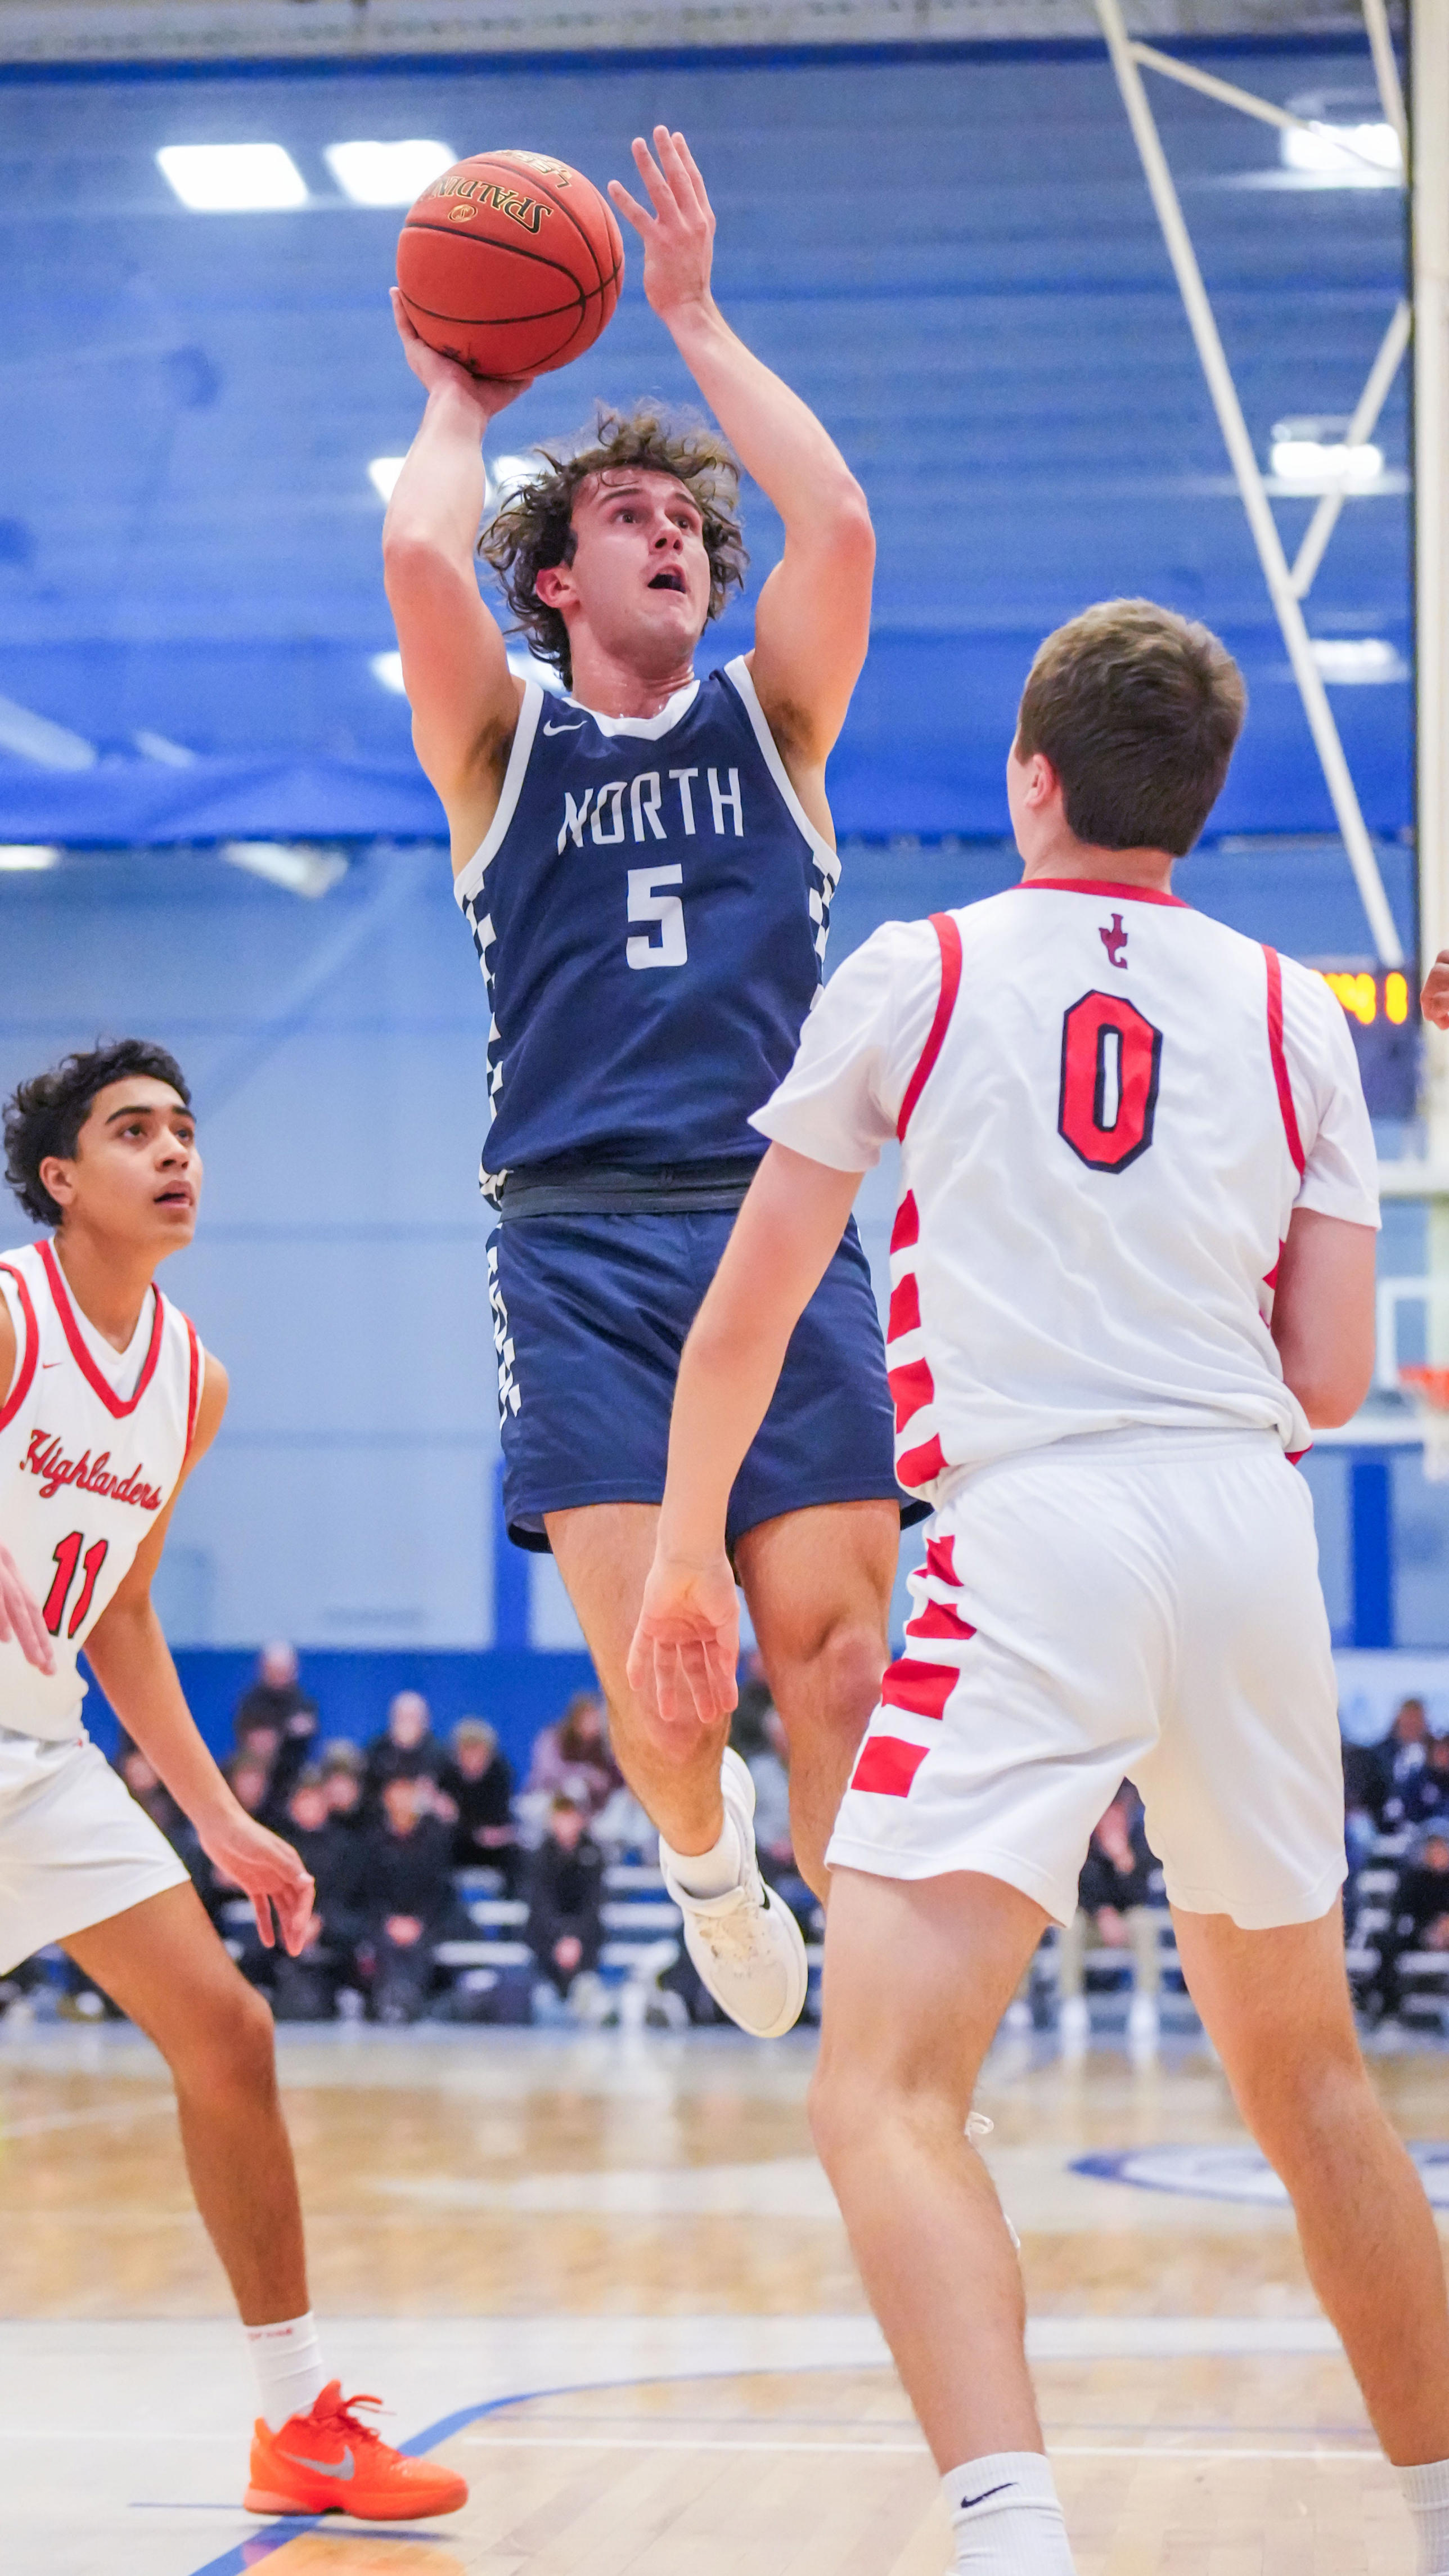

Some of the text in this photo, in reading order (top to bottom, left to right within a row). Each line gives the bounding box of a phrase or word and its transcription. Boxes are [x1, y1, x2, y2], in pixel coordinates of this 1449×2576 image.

[420, 176, 554, 235] SPALDIN
[557, 767, 744, 855] NORTH
[626, 864, 688, 969] 5
[1058, 989, 1163, 1175] 0
[20, 1429, 162, 1510] Highlanders
[42, 1531, 108, 1639] 11
